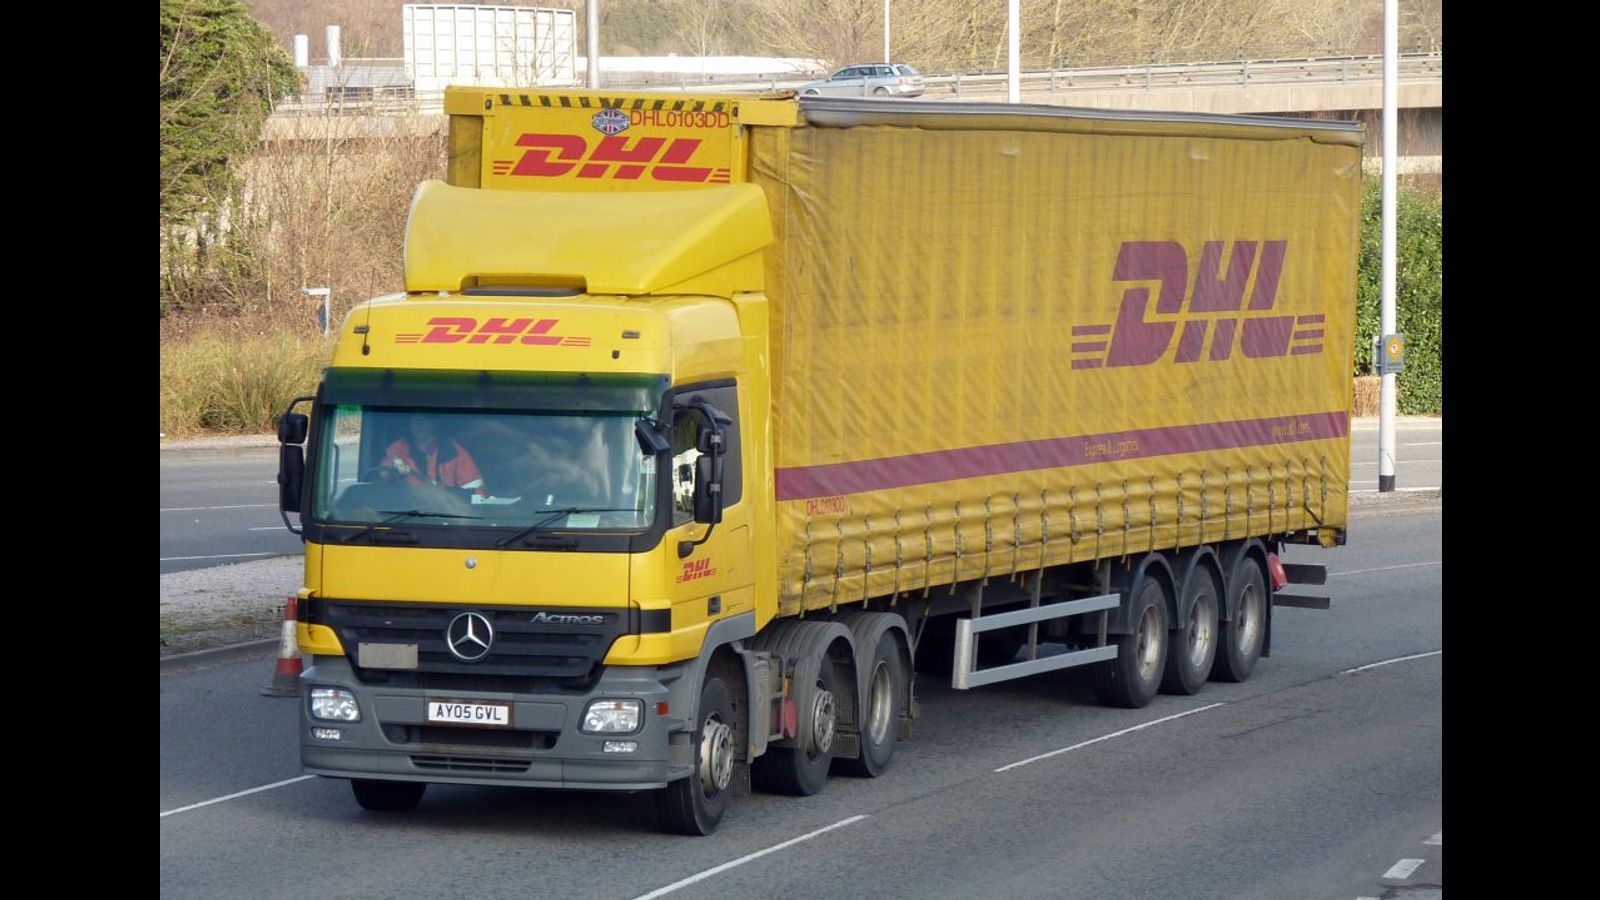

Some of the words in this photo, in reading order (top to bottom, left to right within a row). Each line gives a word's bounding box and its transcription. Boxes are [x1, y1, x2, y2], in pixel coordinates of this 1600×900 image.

[630, 110, 730, 128] DHL0103DD
[508, 133, 714, 183] DHL
[1105, 240, 1296, 367] DHL
[420, 317, 564, 346] DHL
[682, 557, 712, 582] DHL
[436, 703, 472, 719] AY05
[475, 706, 502, 721] GVL
